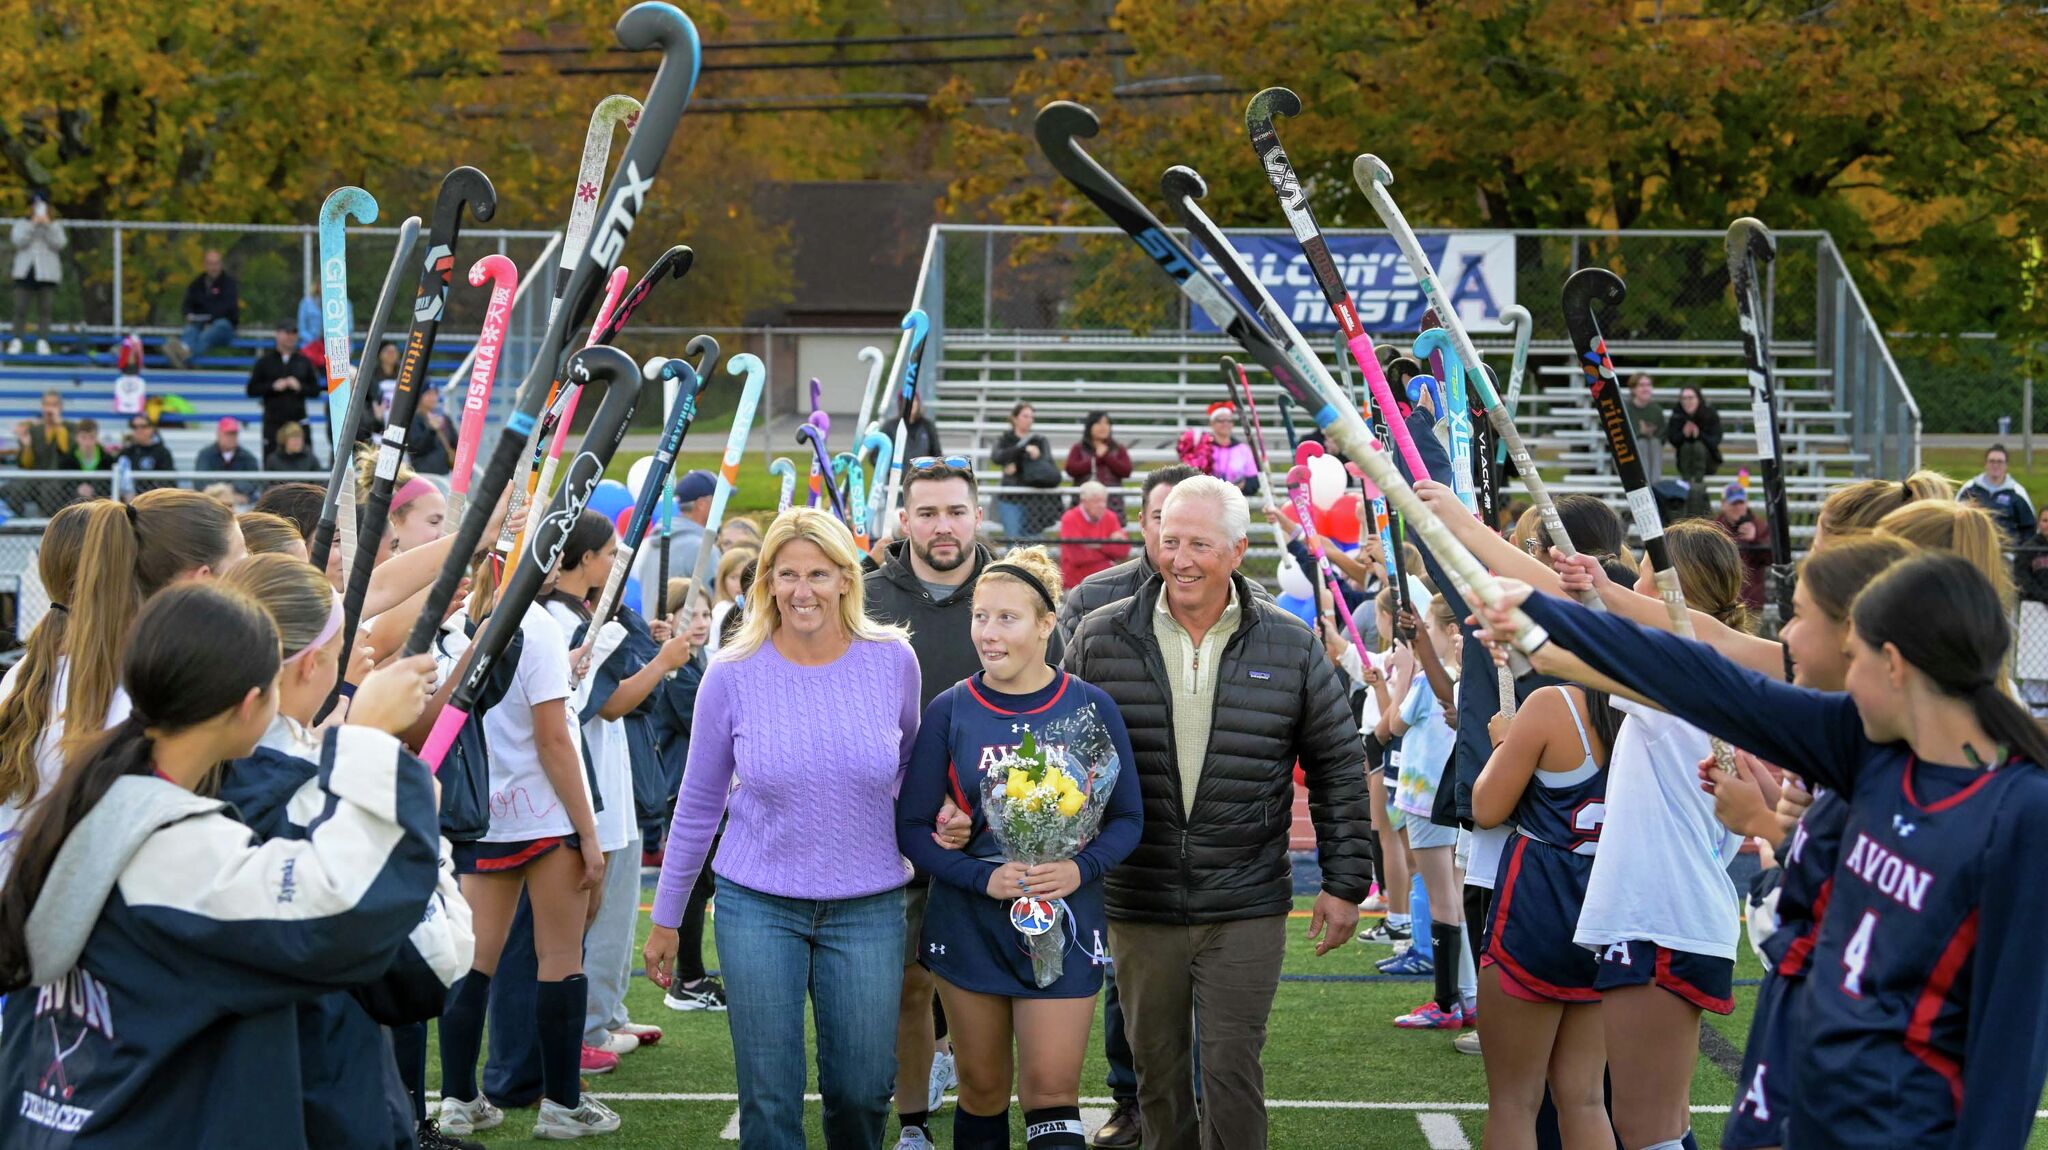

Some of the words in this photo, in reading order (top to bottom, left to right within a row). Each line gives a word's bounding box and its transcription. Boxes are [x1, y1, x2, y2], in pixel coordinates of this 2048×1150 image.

[590, 160, 654, 271] STX
[1135, 228, 1198, 285] ST
[1200, 252, 1419, 286] FLCN'S
[326, 258, 346, 337] Gray
[1449, 254, 1502, 320] A
[399, 330, 424, 393] ritual
[466, 345, 496, 410] OSAKA
[903, 361, 918, 401] STX
[668, 394, 694, 452] GRYPHON
[1449, 409, 1469, 457] STX
[1601, 397, 1635, 465] ritual
[1479, 432, 1490, 490] VLACK
[978, 744, 1065, 770] AVN
[1845, 832, 1935, 912] AVON
[1603, 941, 1632, 966] A
[1841, 909, 1878, 998] 4
[1738, 1063, 1770, 1121] A
[1029, 1121, 1068, 1138] CAPTAIN
